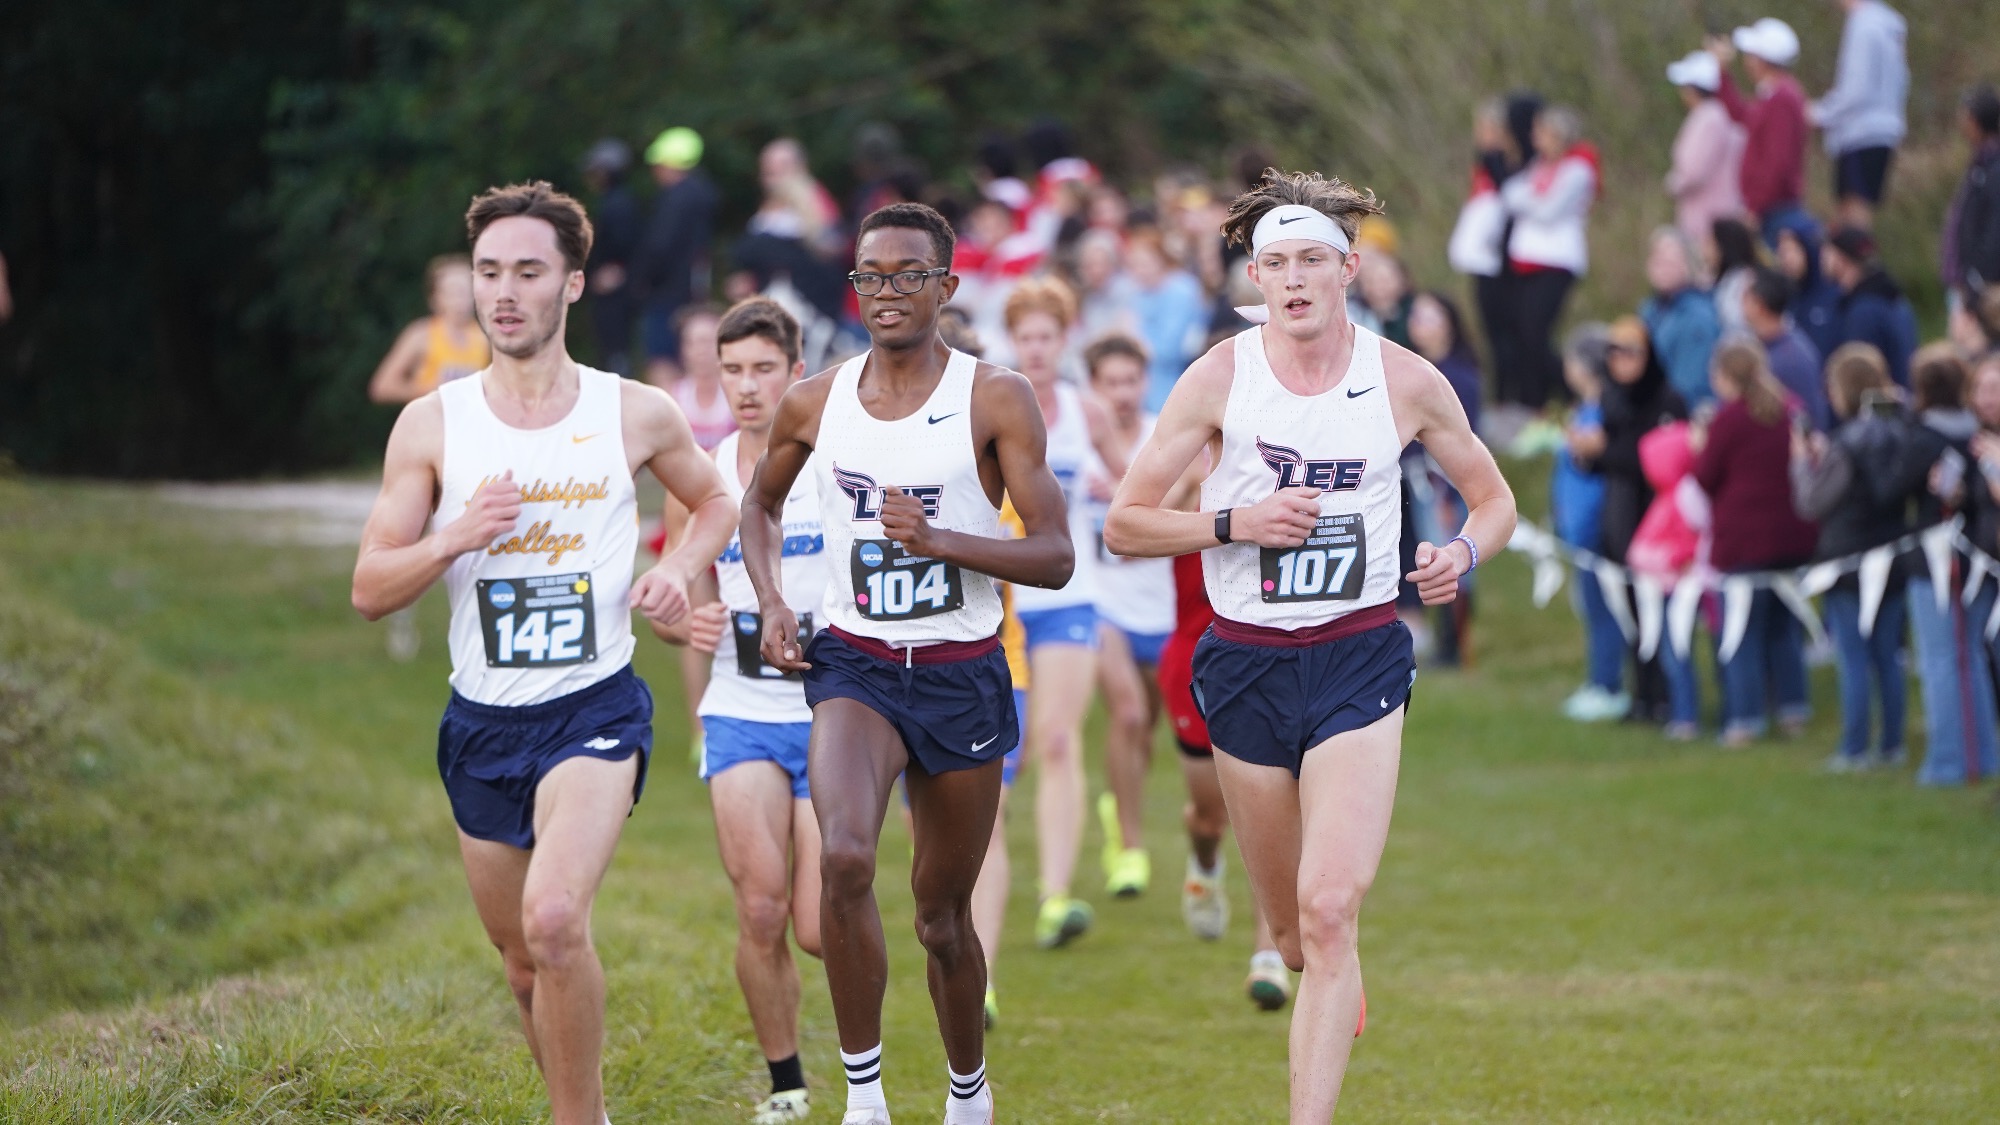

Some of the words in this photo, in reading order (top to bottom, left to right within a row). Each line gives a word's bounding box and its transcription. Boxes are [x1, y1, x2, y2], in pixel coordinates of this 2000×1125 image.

[464, 475, 609, 509] sissippi
[1275, 459, 1367, 492] LEE
[862, 553, 884, 561] NCAA
[1277, 546, 1358, 596] 107
[866, 562, 950, 615] 104
[495, 608, 585, 662] 142
